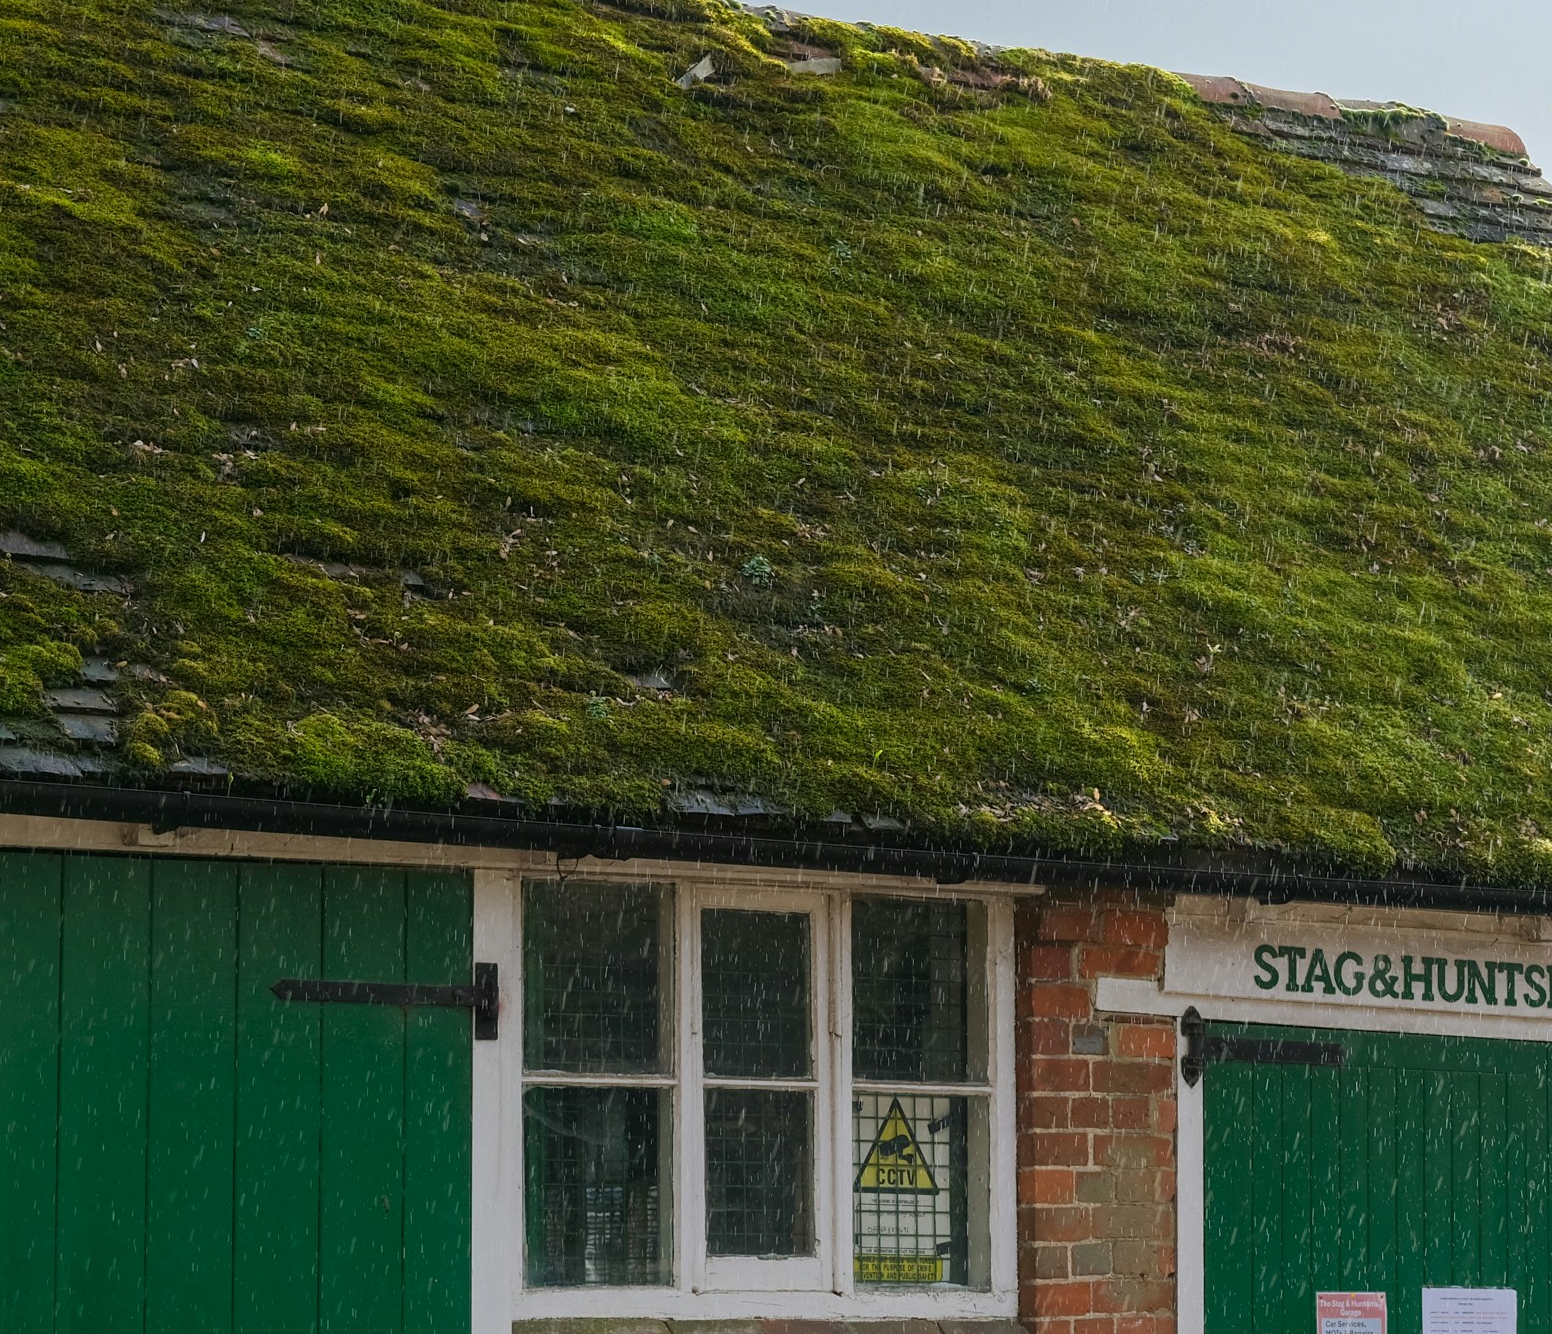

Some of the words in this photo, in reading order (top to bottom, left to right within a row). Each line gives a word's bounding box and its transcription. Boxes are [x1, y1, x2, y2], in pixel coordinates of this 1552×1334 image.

[877, 1168, 917, 1186] CCTV
[908, 1264, 915, 1272] OF
[1331, 1300, 1345, 1308] Stag
[1340, 1309, 1362, 1317] Garage
[1337, 1320, 1367, 1328] Services,
